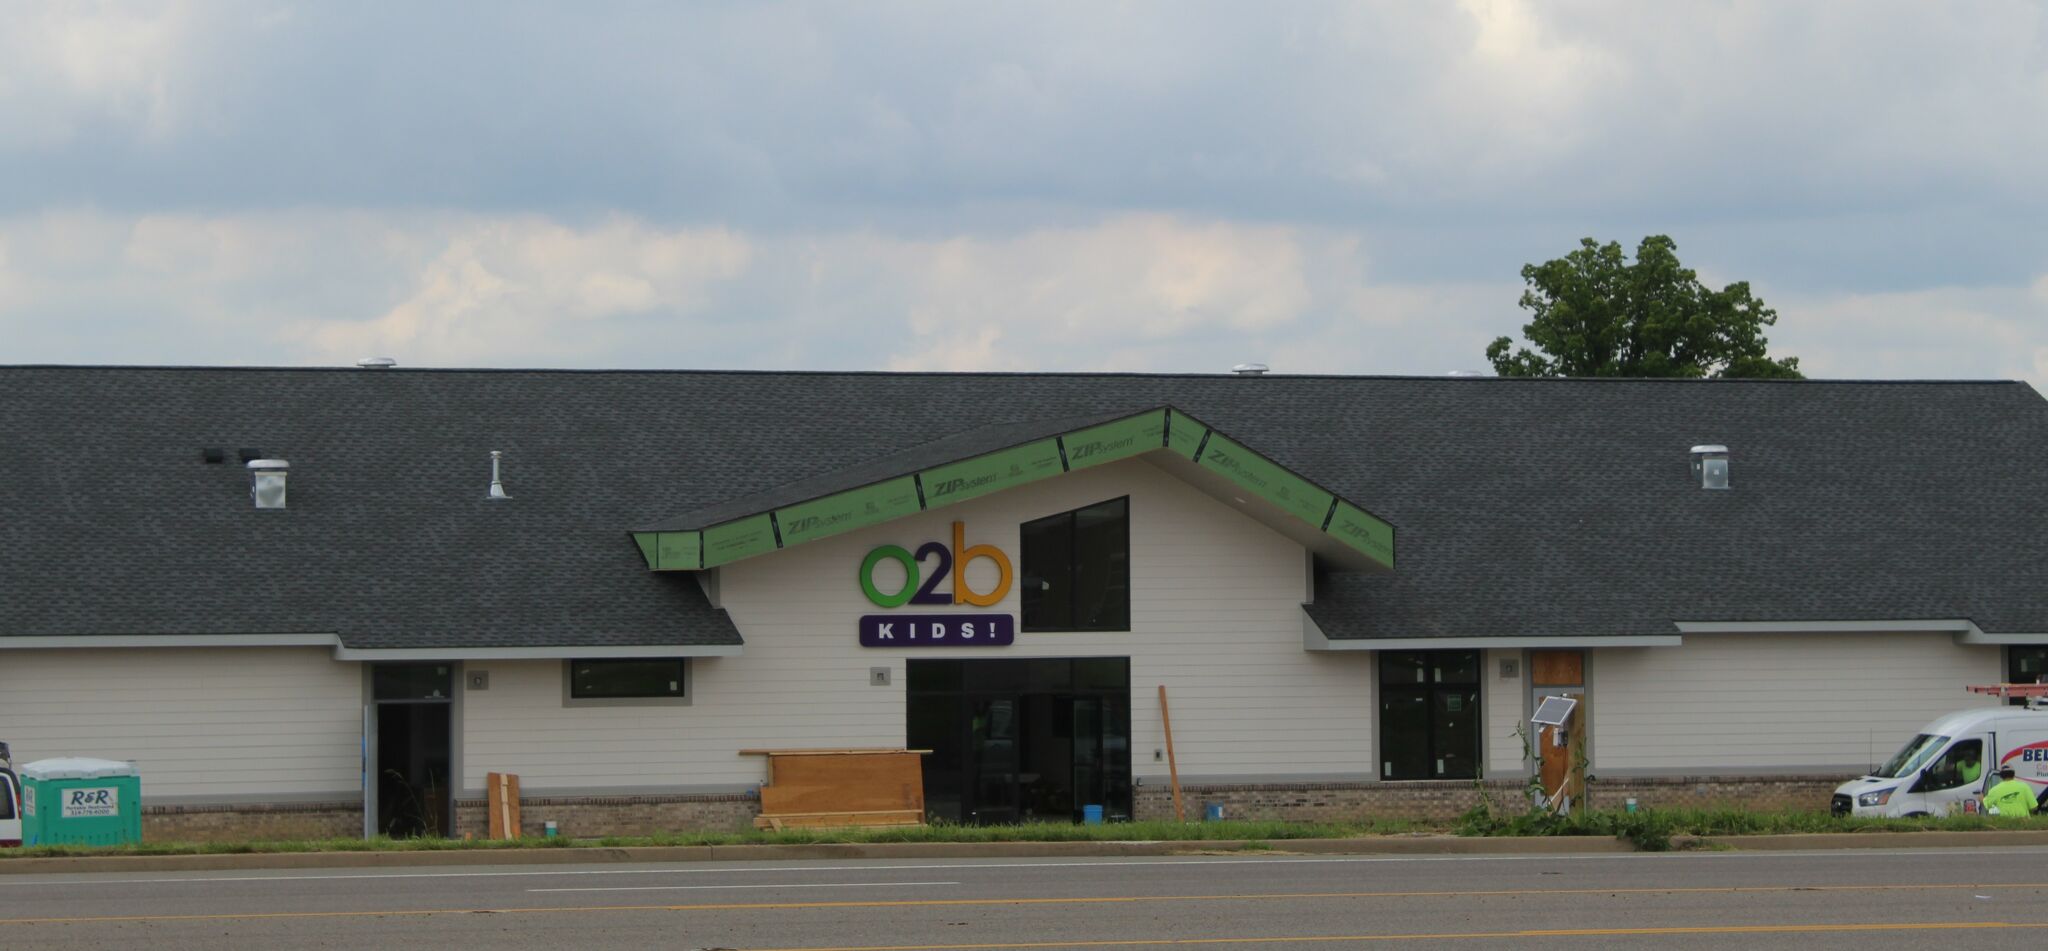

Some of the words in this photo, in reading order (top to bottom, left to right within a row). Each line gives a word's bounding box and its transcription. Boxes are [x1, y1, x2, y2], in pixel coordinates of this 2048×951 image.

[859, 521, 1013, 609] o2b
[878, 622, 996, 640] KIDS!
[71, 789, 109, 805] R&R
